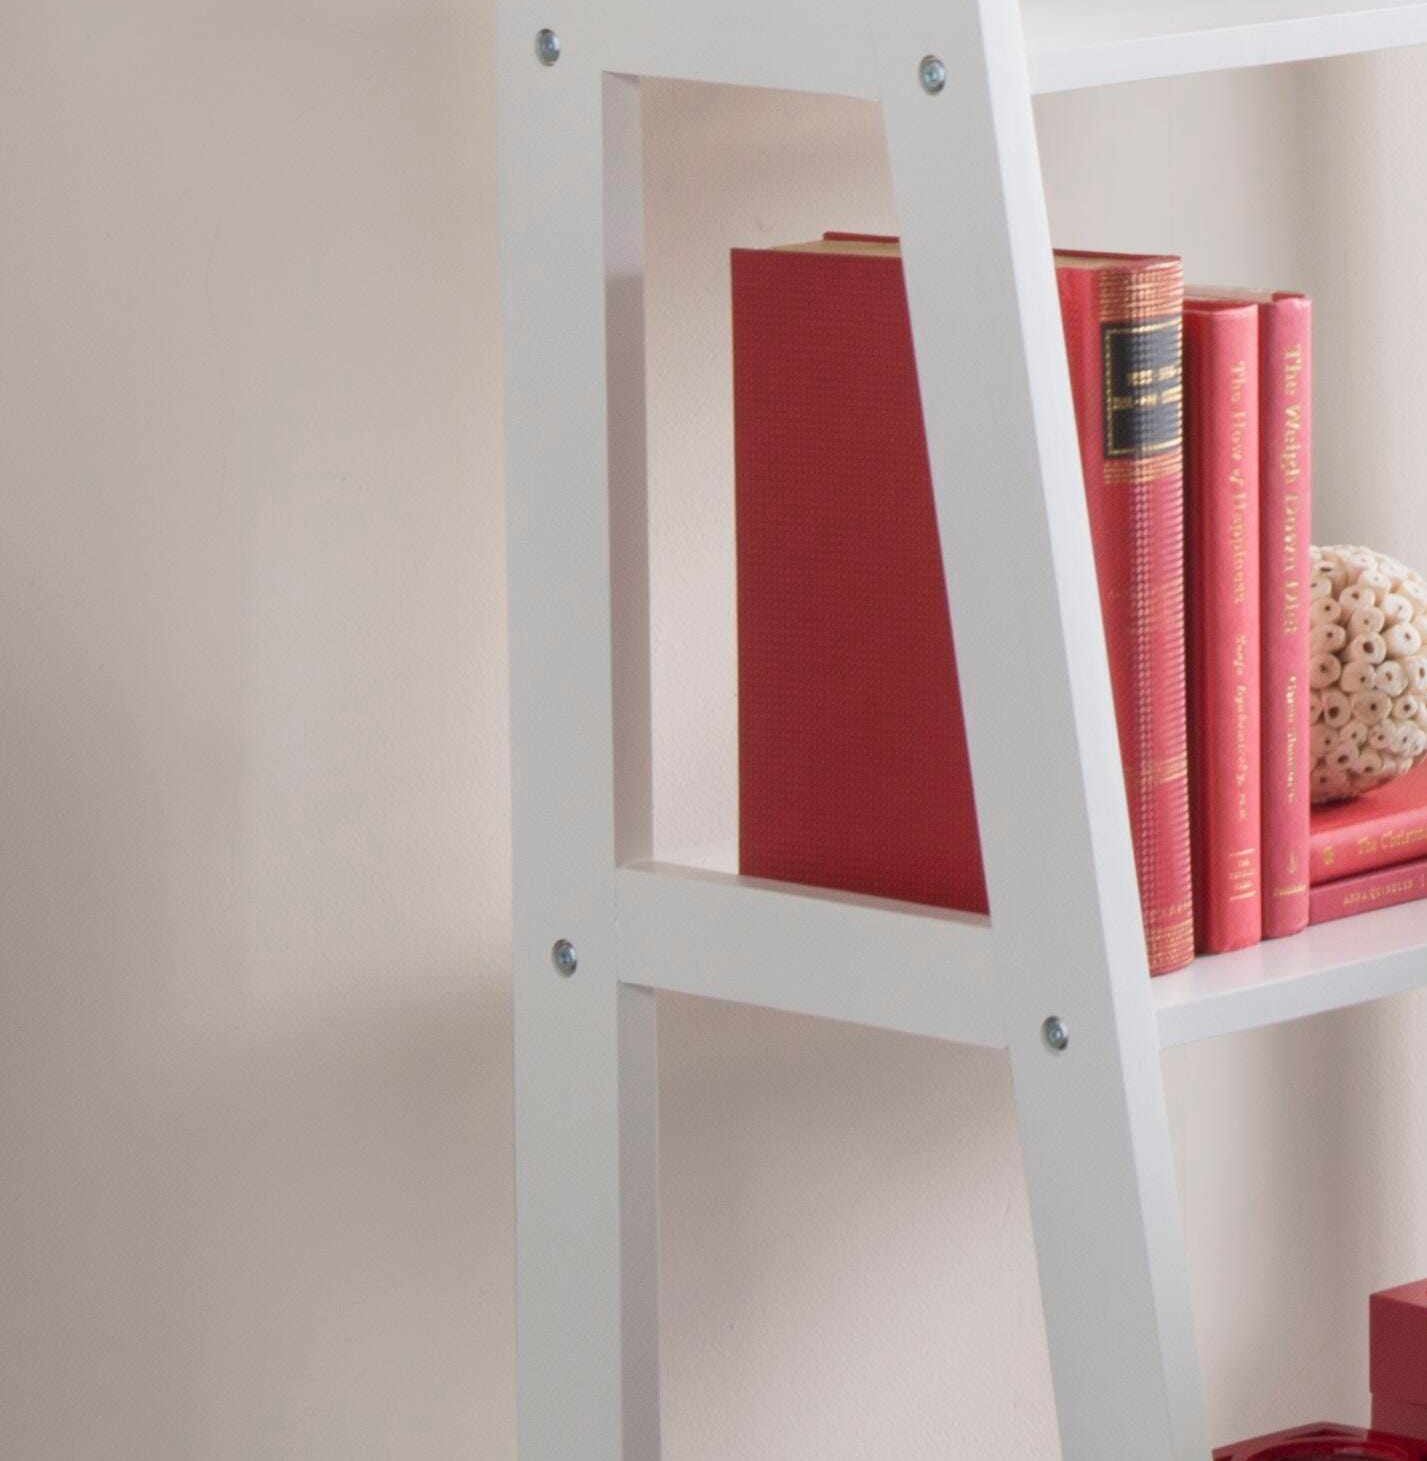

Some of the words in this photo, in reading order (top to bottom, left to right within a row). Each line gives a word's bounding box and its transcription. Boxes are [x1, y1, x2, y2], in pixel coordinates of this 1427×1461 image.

[1231, 361, 1247, 403] The
[1284, 346, 1301, 394] The
[1231, 413, 1246, 461] How
[1280, 404, 1301, 483] Weigh
[1229, 493, 1247, 604] Happiness
[1284, 494, 1299, 572] Down
